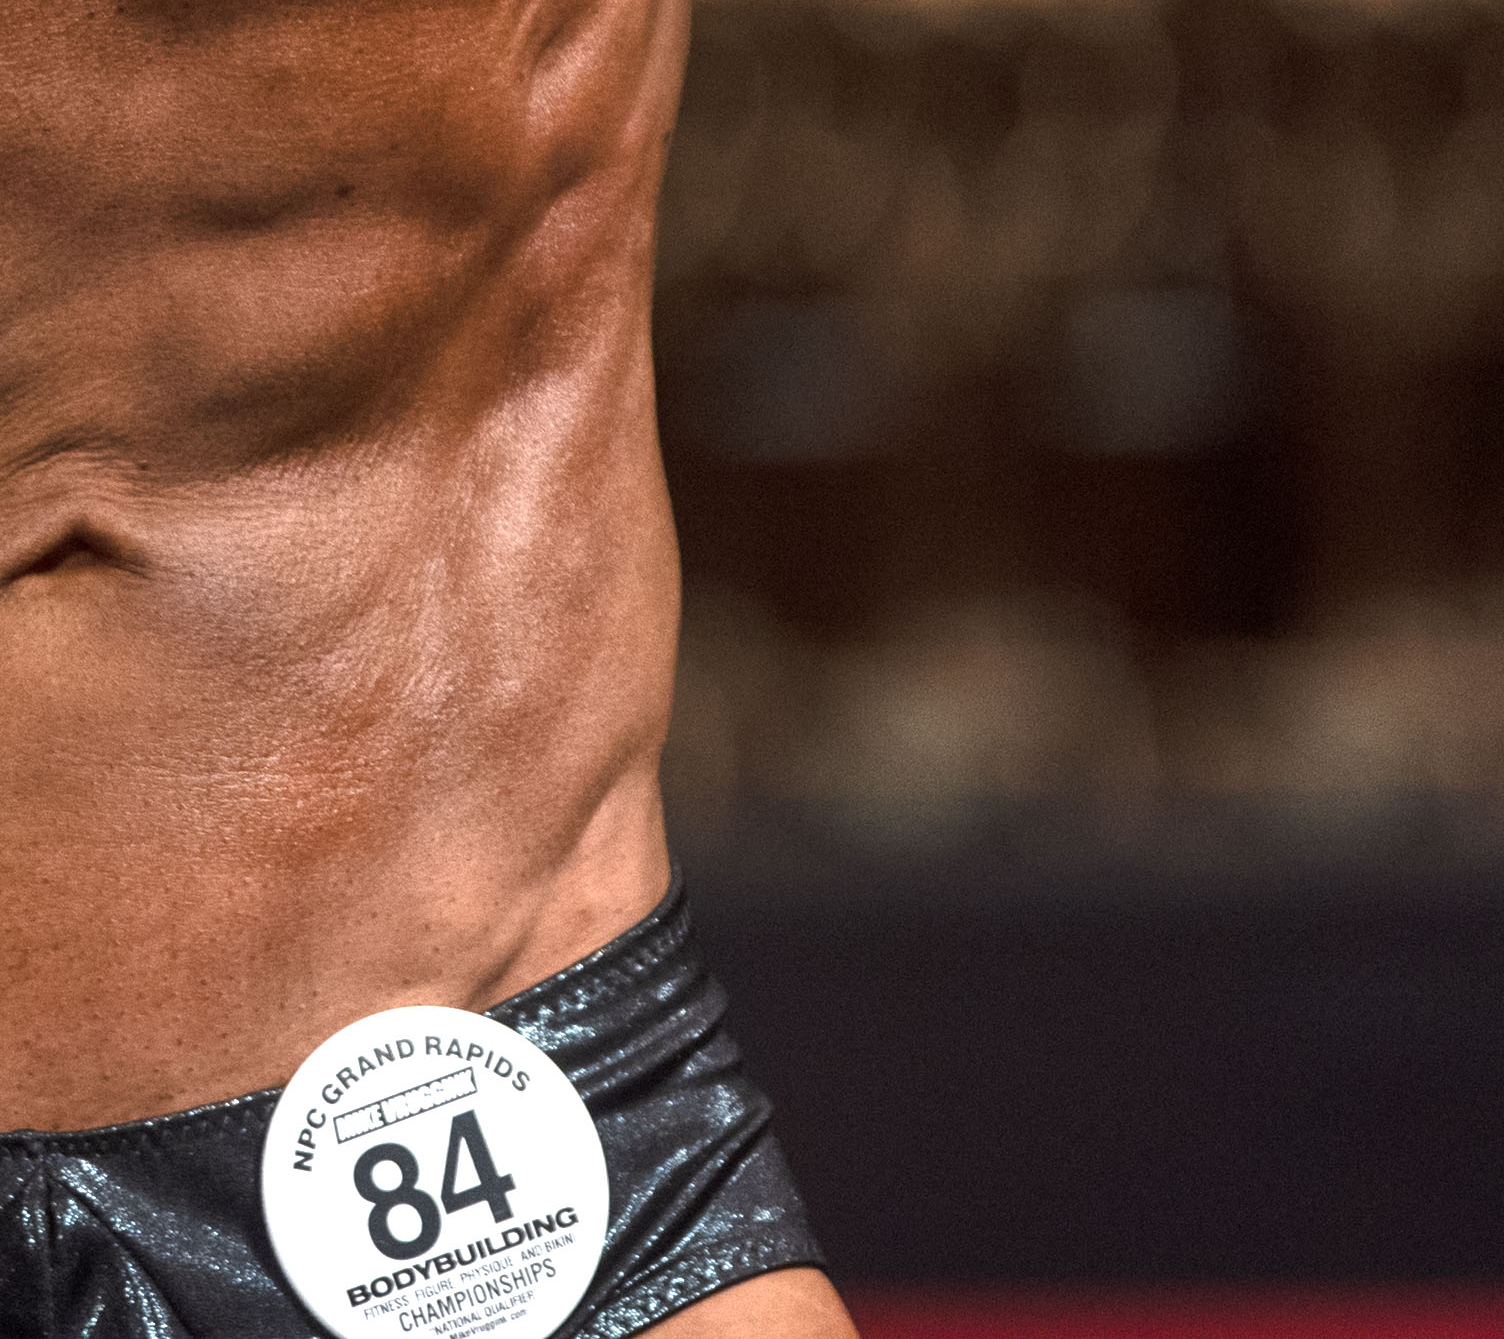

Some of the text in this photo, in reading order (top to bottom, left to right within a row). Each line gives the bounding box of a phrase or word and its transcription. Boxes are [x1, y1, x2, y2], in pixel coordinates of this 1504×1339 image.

[293, 1035, 530, 1172] NPC GRAND RAPIDS
[353, 1109, 517, 1261] 84
[346, 1206, 580, 1307] BODYBUILDING
[363, 1294, 410, 1320] FITNESS
[414, 1278, 454, 1301] FIGURE
[459, 1255, 514, 1284] PHYSIQUE
[520, 1243, 544, 1262] AND
[398, 1257, 557, 1332] CHAMPIONSHIPS
